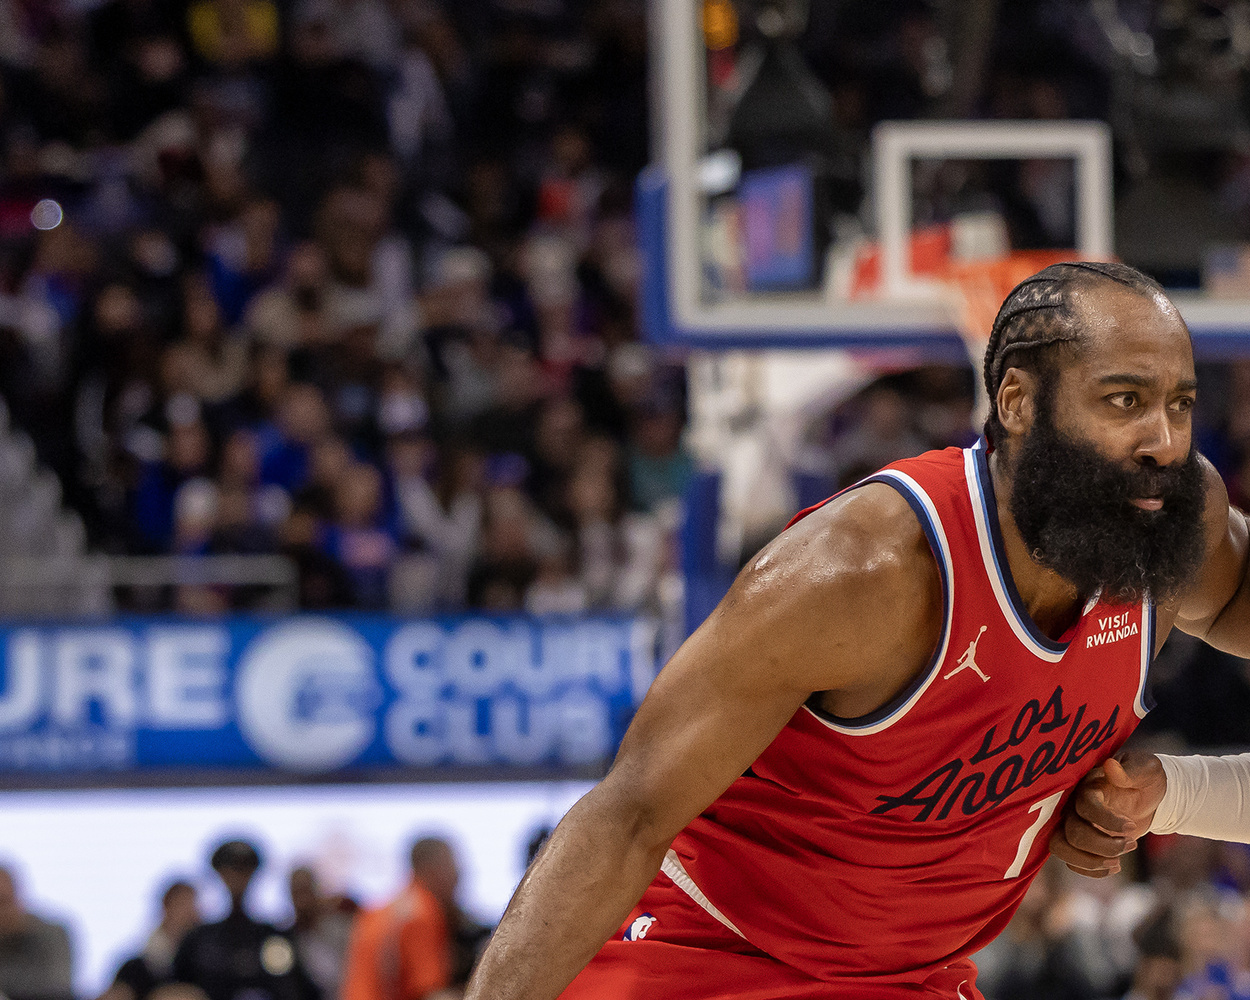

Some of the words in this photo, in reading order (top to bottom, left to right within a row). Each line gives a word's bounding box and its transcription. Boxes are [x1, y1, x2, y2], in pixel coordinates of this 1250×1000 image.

[1086, 622, 1139, 649] RWANDA
[1098, 610, 1131, 632] VISIT
[386, 694, 609, 768] CLUB
[968, 684, 1071, 766] Los
[867, 704, 1120, 823] Angeles
